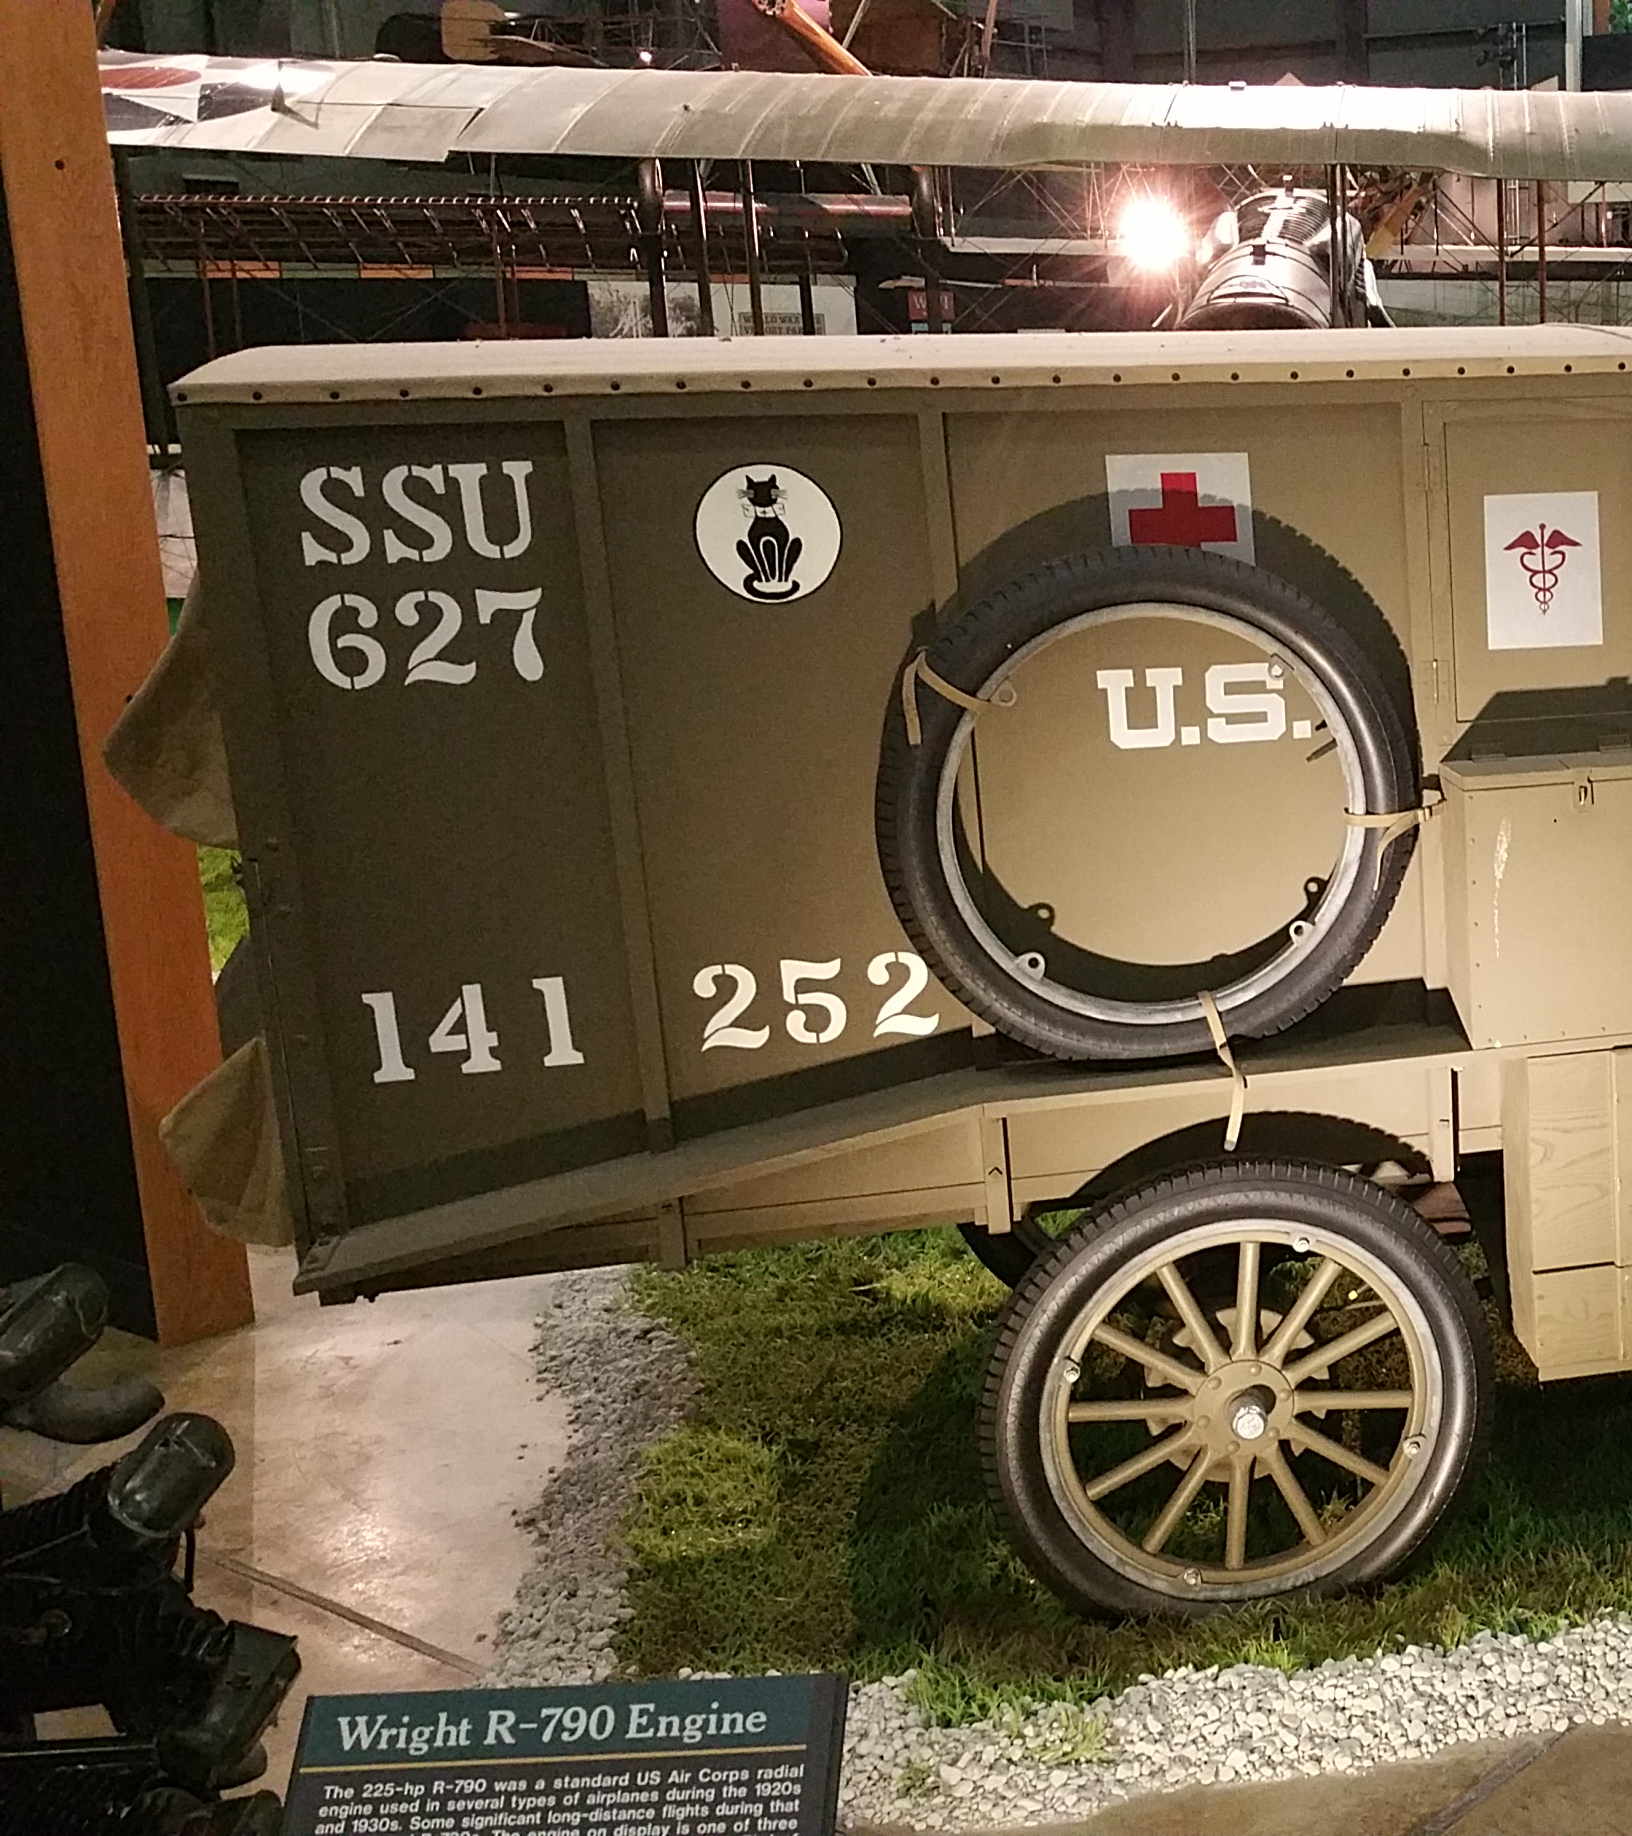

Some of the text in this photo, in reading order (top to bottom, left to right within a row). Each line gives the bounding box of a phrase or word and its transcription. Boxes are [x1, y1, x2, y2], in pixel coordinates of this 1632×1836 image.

[300, 461, 533, 566] SSU
[308, 587, 544, 690] 627
[1096, 663, 1312, 749] U.S.
[362, 951, 940, 1083] 141 252
[337, 1701, 768, 1756] Wright R-790 Engine
[319, 1781, 802, 1818] engine used in several types of airplanes during the 1920s
[323, 1763, 805, 1800] The 225-hp R-790 was a standard US Air Corps radial
[315, 1820, 346, 1835] and
[351, 1817, 403, 1832] 1930s.
[409, 1815, 456, 1831] Some
[462, 1811, 541, 1830] significant
[547, 1808, 656, 1826] long-distance
[662, 1803, 709, 1820] flights
[716, 1801, 764, 1818] during
[770, 1798, 800, 1813] that
[587, 1826, 607, 1836] on
[614, 1823, 670, 1836] display
[676, 1820, 690, 1835] is
[697, 1821, 727, 1834] one
[733, 1818, 751, 1832] of
[757, 1817, 798, 1831] three
